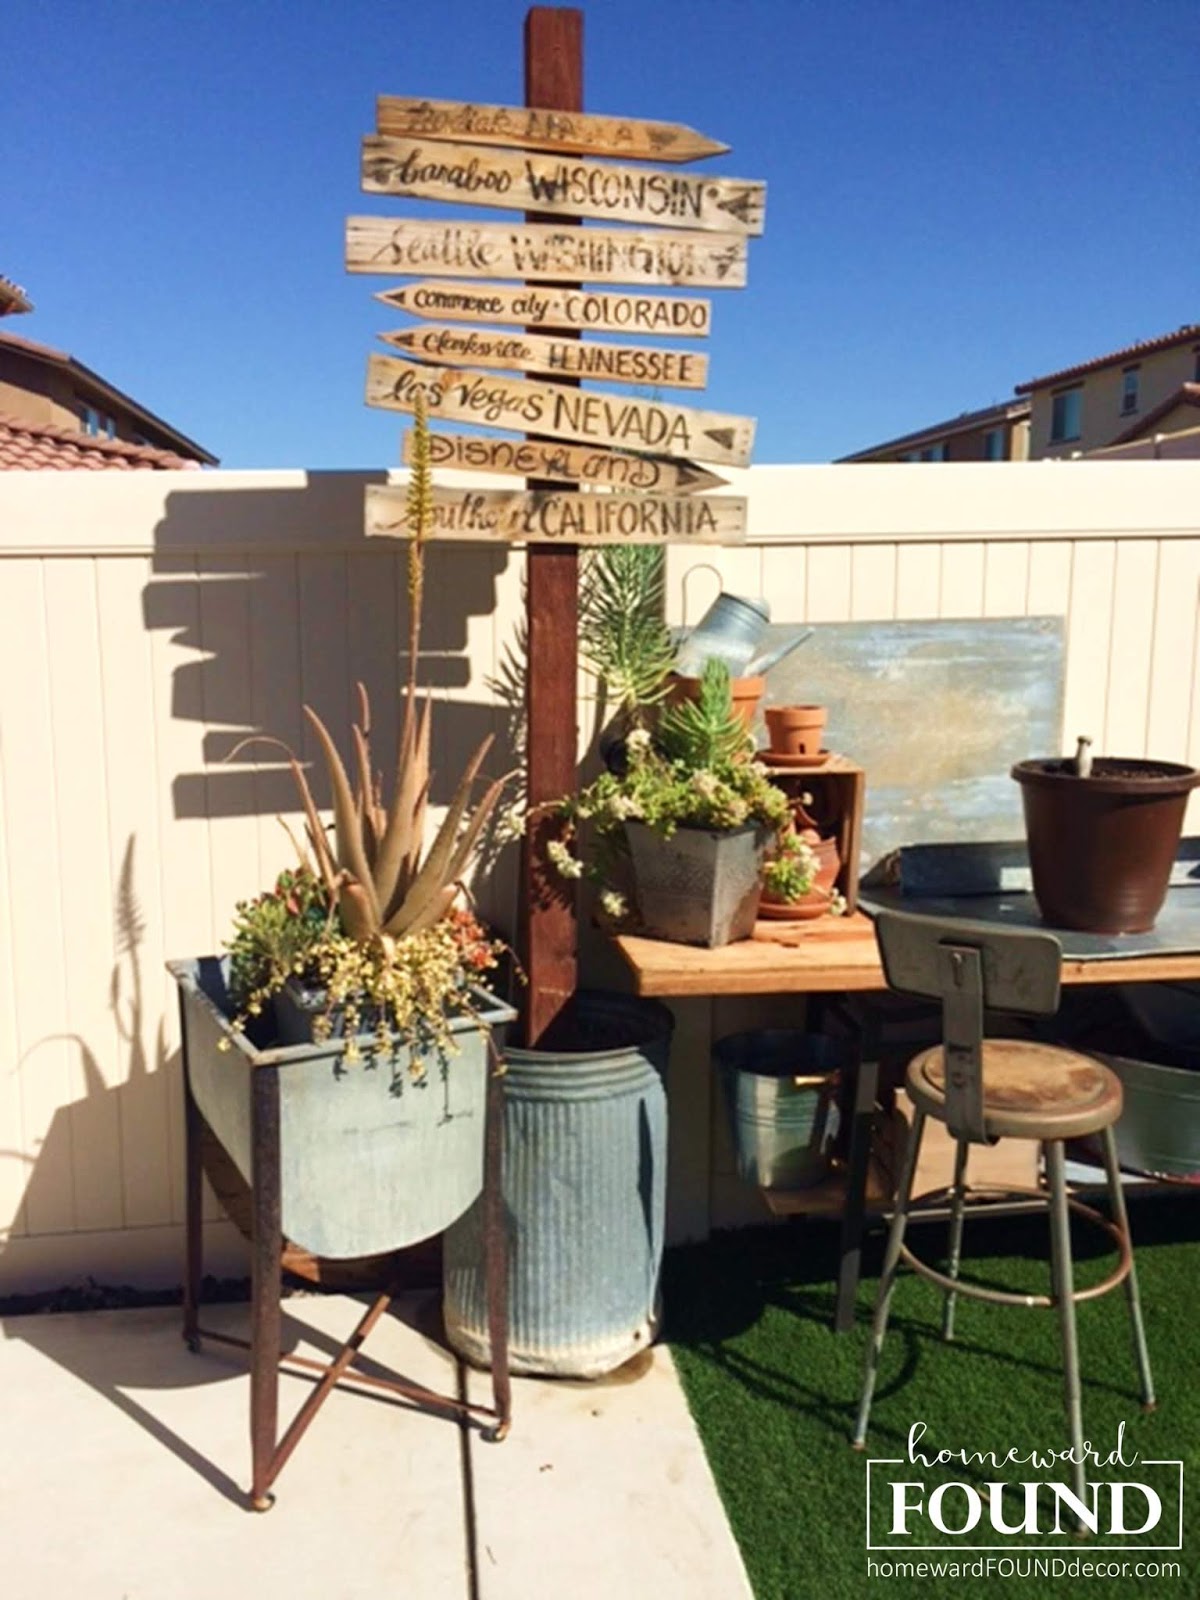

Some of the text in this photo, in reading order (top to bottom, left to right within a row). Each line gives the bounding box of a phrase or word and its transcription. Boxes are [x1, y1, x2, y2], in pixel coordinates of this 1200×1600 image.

[524, 111, 634, 146] ALAA
[398, 148, 702, 219] baraboo WISCONSIN
[566, 299, 707, 329] COLORADO
[549, 342, 693, 382] TENNESSEE
[553, 392, 692, 451] NEVADA
[383, 491, 719, 539] outhen CALIFORNIA
